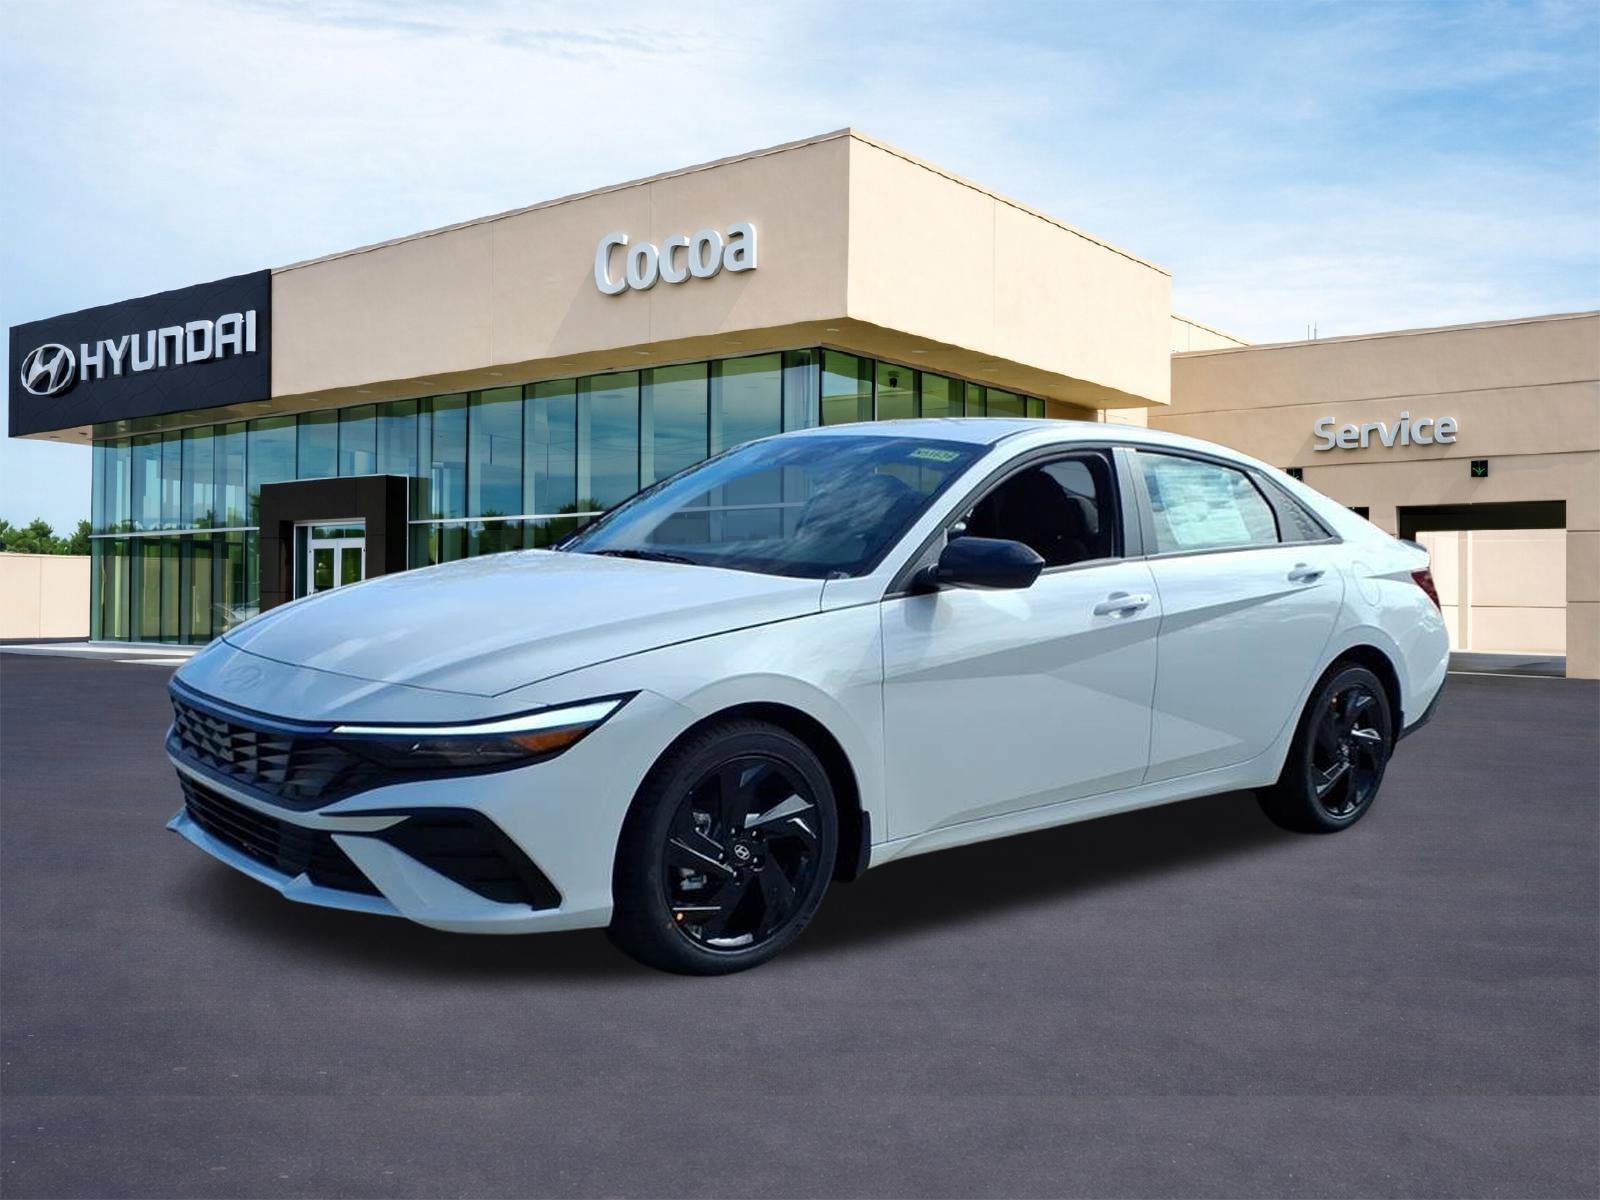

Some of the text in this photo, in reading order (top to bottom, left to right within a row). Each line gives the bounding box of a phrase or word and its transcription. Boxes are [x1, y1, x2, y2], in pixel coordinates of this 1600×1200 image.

[594, 222, 757, 295] Cocoa
[80, 309, 256, 381] HYUNDAI
[1313, 410, 1457, 451] Service
